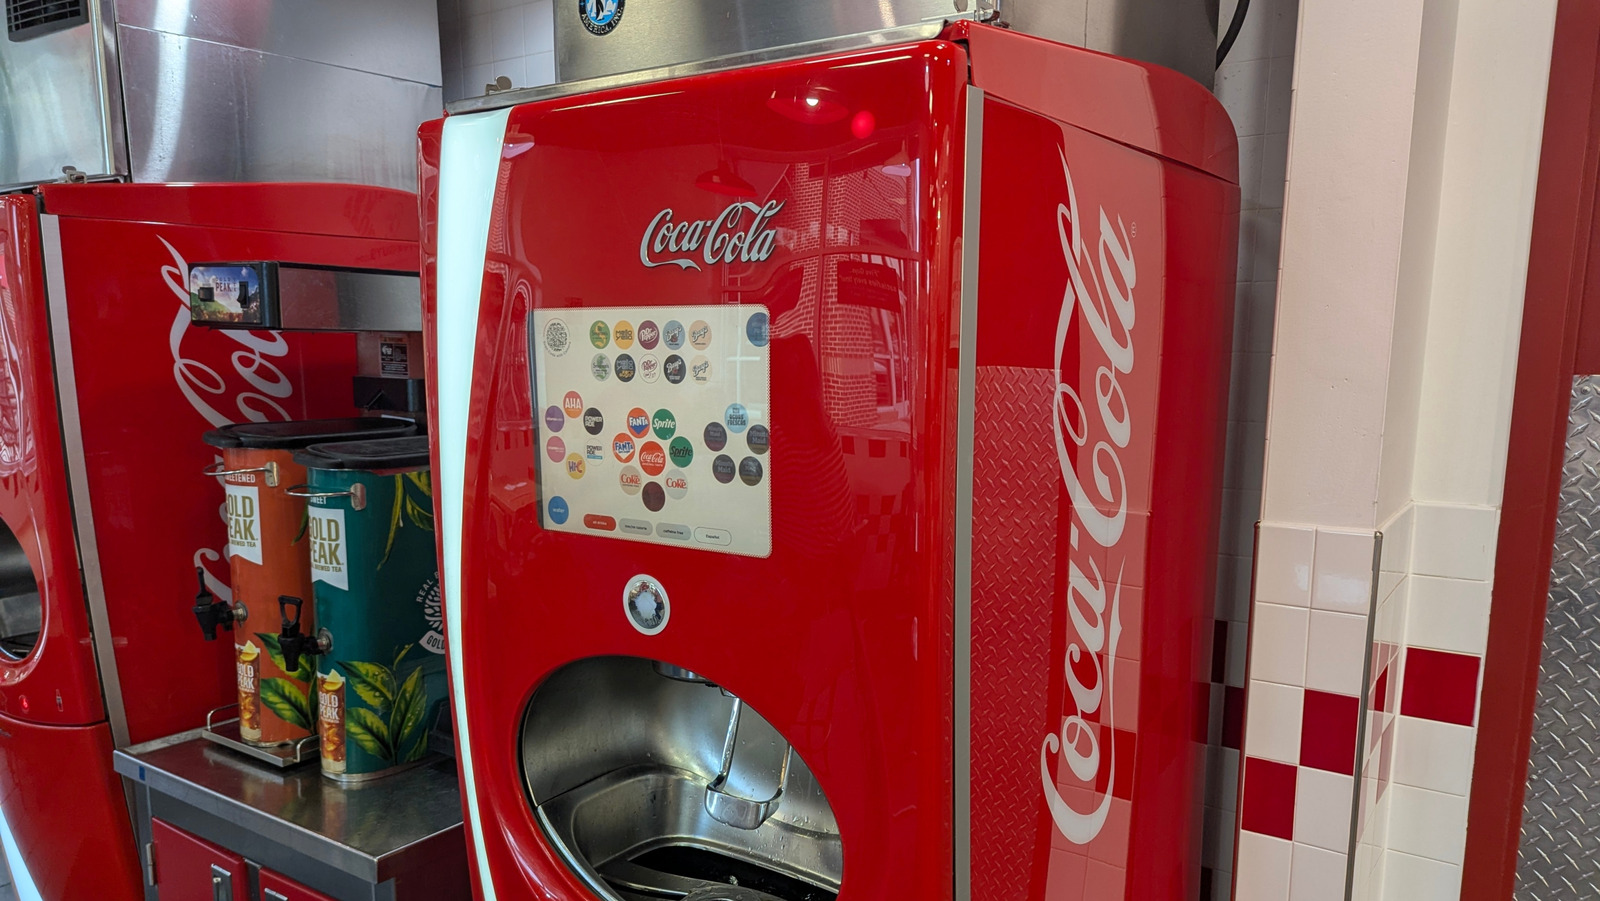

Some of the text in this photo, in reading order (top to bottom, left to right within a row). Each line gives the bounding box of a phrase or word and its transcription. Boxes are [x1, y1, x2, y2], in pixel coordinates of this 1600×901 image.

[640, 199, 787, 272] Coca-Cola
[565, 397, 581, 409] AHA
[629, 416, 649, 427] FANTA
[653, 418, 676, 429] Sprite
[614, 442, 634, 450] FANTA
[670, 445, 693, 457] Sprite
[640, 451, 664, 463] Coca-Cola
[620, 473, 641, 485] Coke
[666, 477, 687, 489] Coke
[1041, 140, 1138, 845] Coca-Cola
[226, 493, 254, 518] OLD
[228, 517, 255, 541] EAK
[416, 579, 433, 603] REAL
